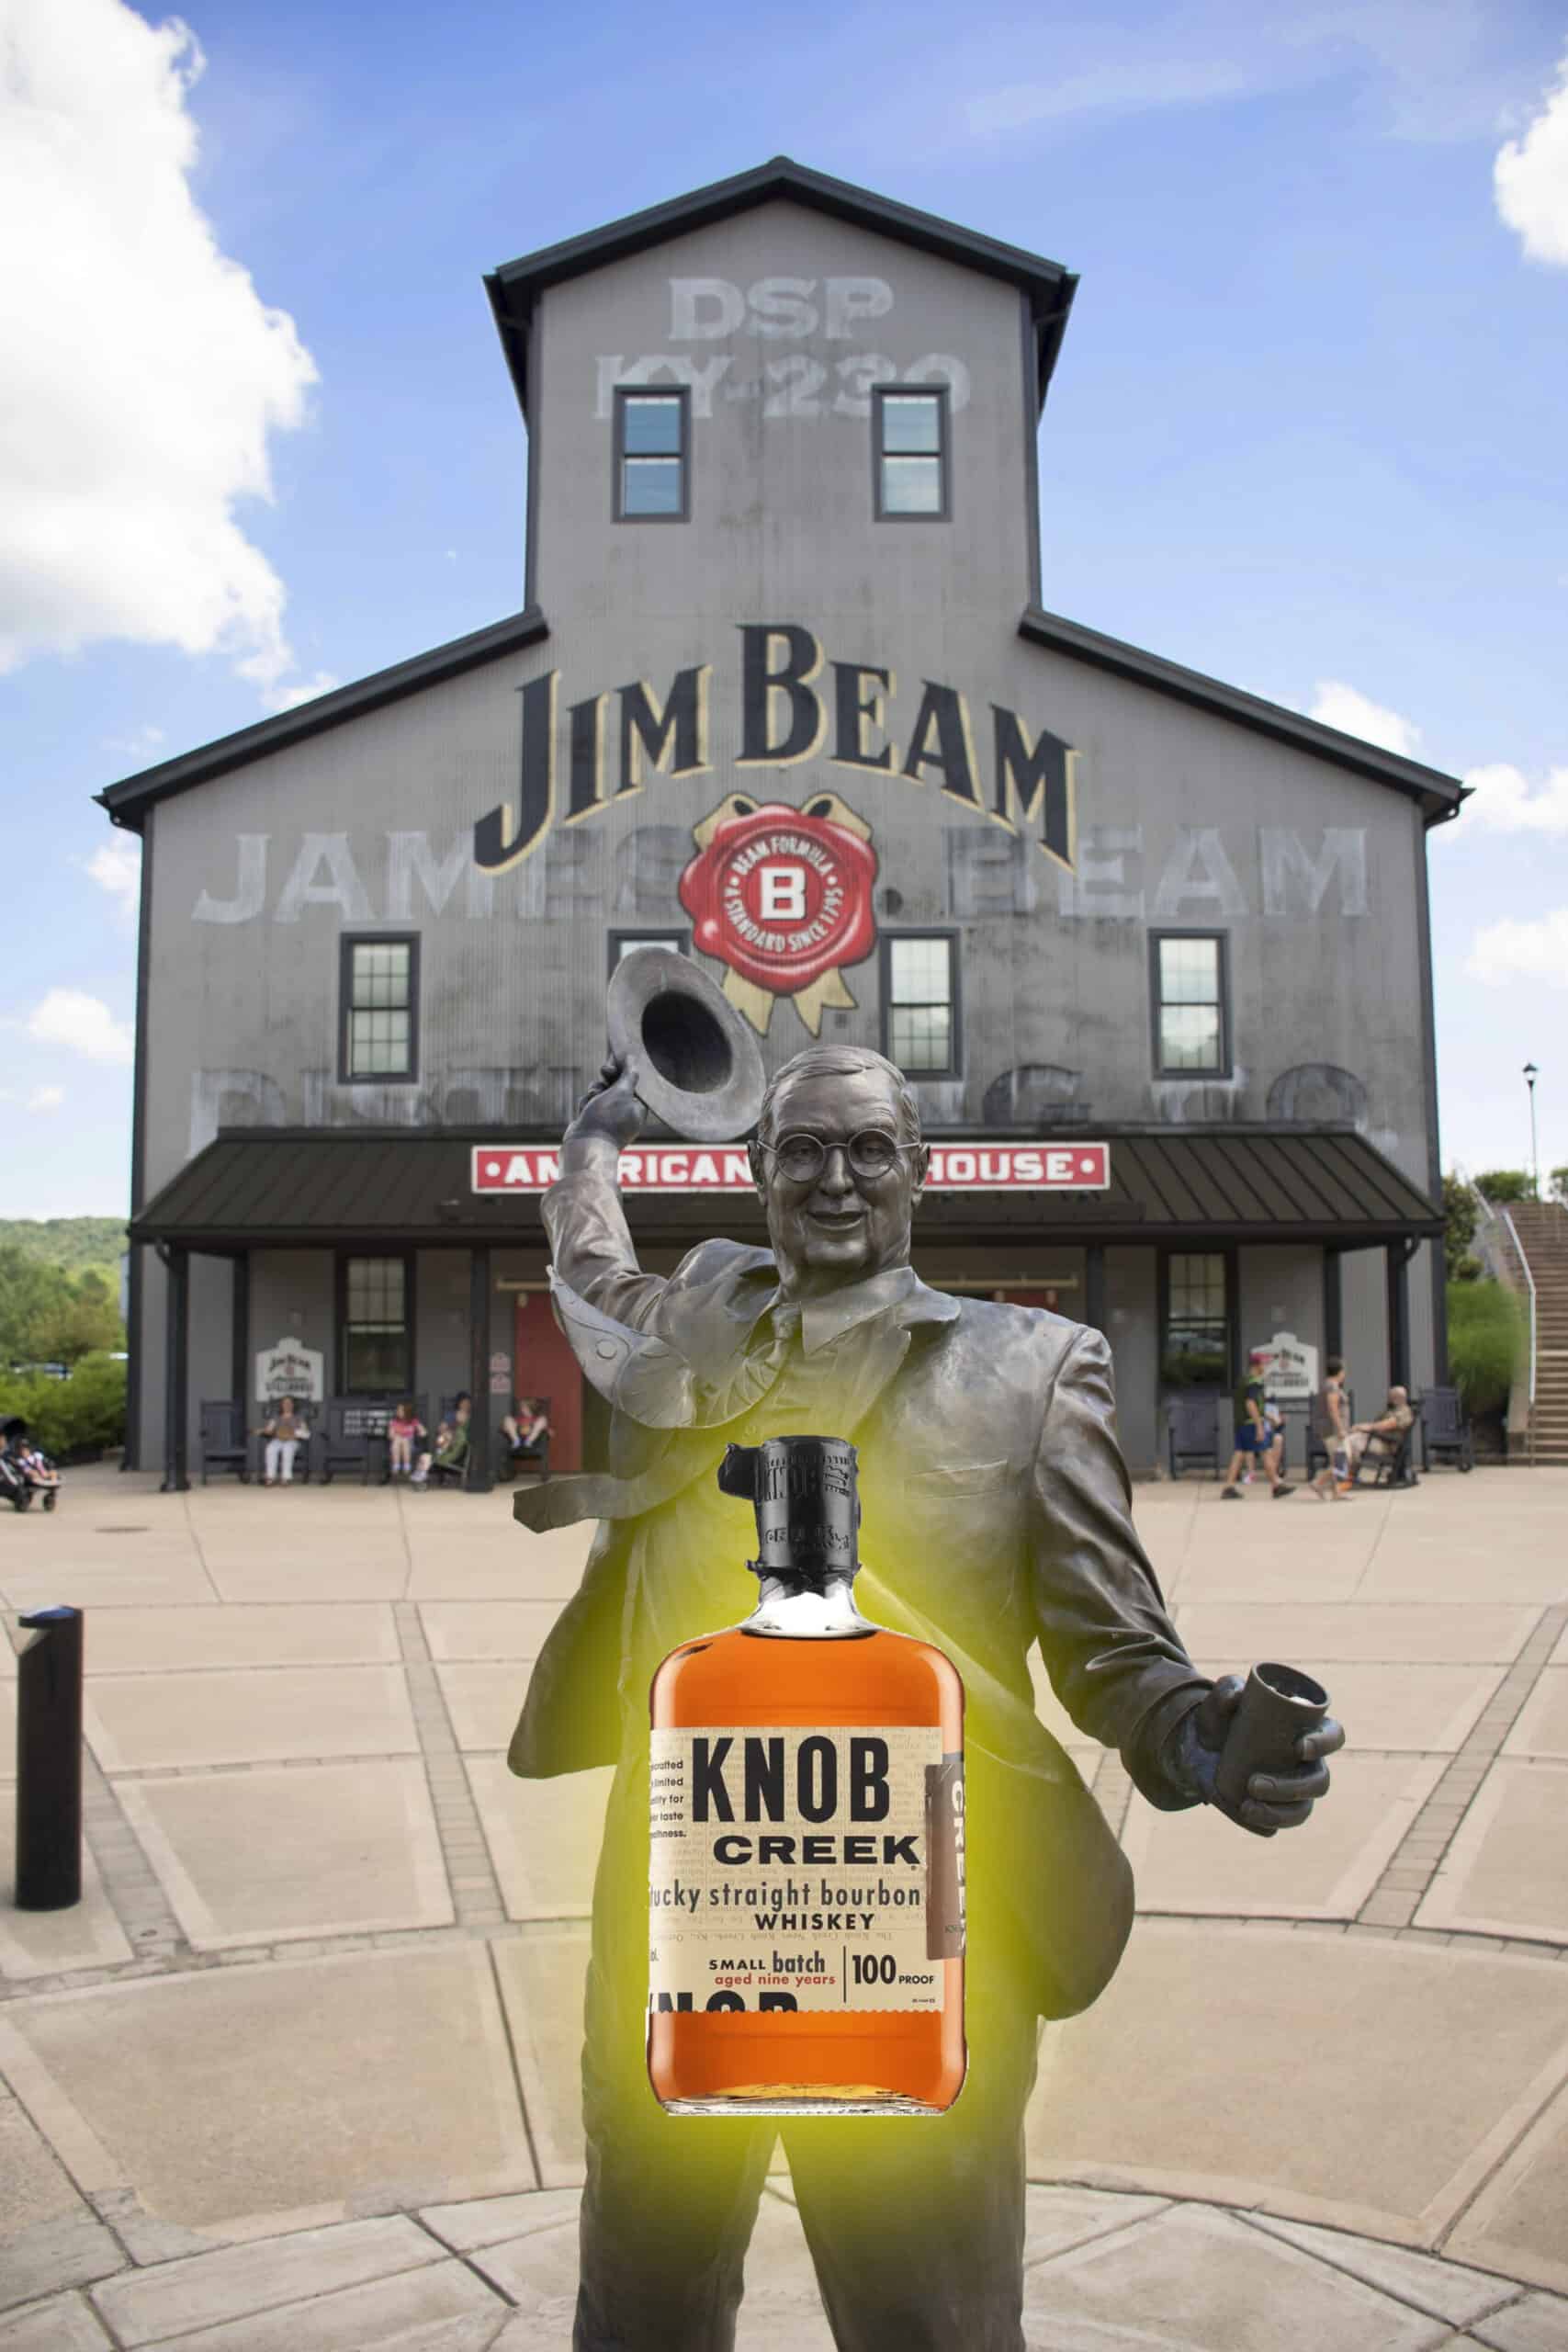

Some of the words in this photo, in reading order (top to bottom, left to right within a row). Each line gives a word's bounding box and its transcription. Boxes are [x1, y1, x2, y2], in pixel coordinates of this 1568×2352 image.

[669, 278, 895, 340] DSP
[474, 664, 714, 877] JIM
[735, 623, 1083, 875] BEAM
[731, 839, 772, 876] BEAM
[770, 835, 835, 875] FORMULA
[761, 866, 807, 920] B
[788, 920, 829, 952] SINCE
[504, 1154, 755, 1184] ARICAN
[693, 1736, 890, 1823] KNOB
[670, 1794, 684, 1803] for
[713, 1836, 920, 1865] CREEK
[709, 1878, 811, 1912] straight
[820, 1879, 920, 1905] bourbon
[755, 1913, 875, 1930] WHISKEY
[708, 1959, 766, 1971] SMALL
[773, 1950, 825, 1973] batch
[852, 1954, 897, 1984] 100
[898, 1975, 934, 1984] PROOF
[715, 1973, 752, 1987] aged
[758, 1973, 789, 1984] nine
[795, 1976, 836, 1987] years
